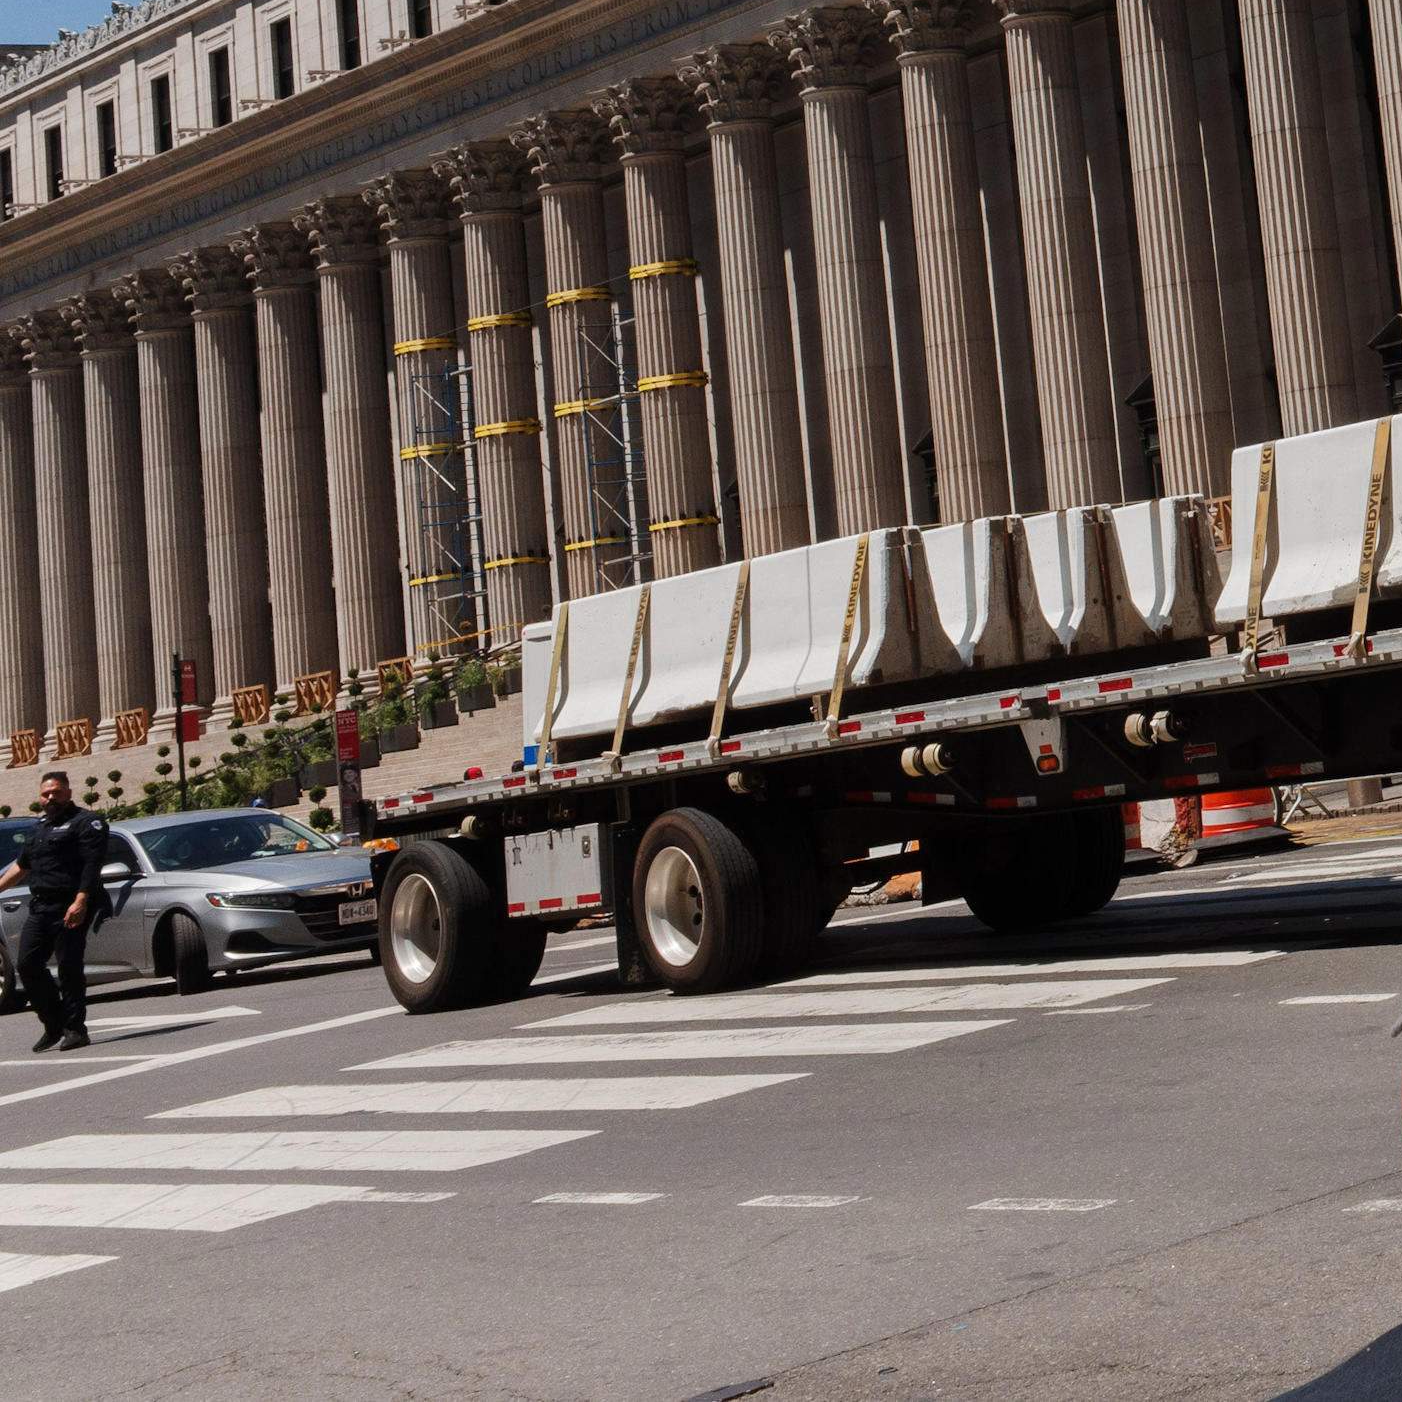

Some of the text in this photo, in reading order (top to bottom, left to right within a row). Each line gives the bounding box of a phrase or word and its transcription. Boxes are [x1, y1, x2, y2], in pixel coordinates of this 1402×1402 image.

[366, 110, 424, 150] STAYS
[432, 77, 495, 122] THESE
[506, 30, 617, 91] COURIERS
[630, 0, 694, 39] FROM
[1361, 472, 1383, 566] KINEDYNE
